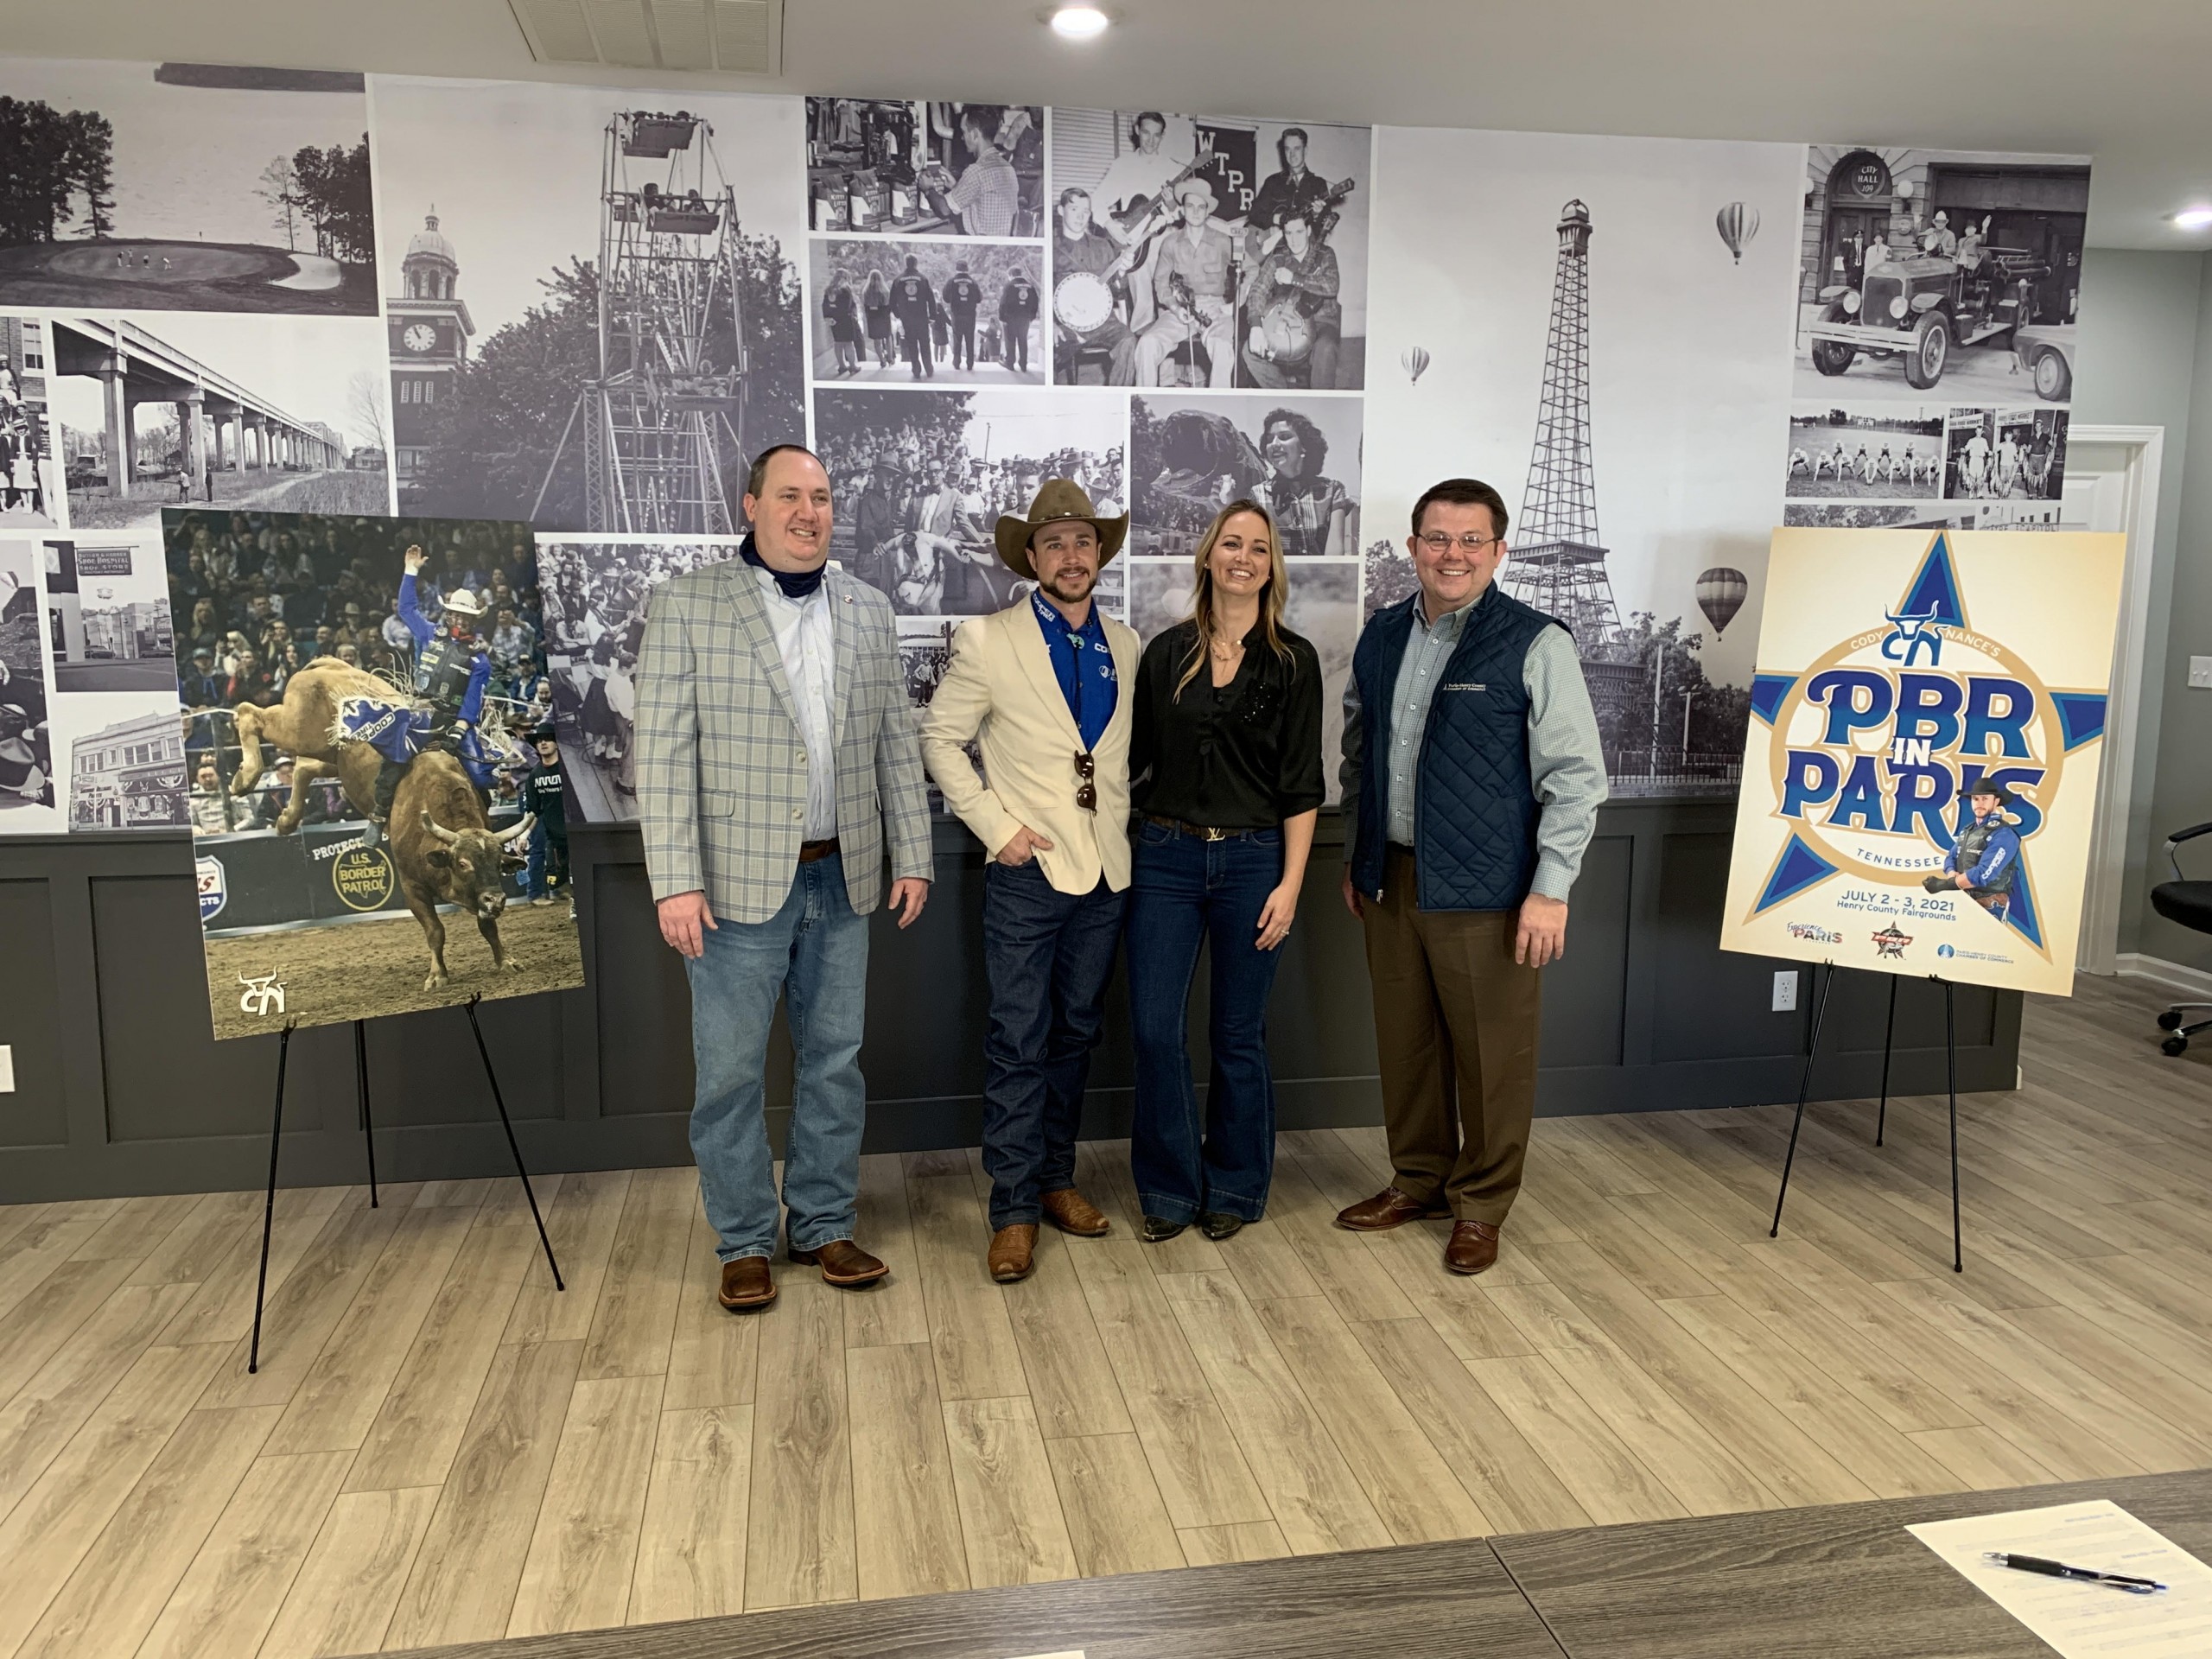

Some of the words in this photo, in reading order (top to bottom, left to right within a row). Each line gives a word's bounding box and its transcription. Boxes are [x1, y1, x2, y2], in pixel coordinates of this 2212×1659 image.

[1858, 175, 1878, 184] HALL
[1861, 165, 1878, 175] CITY
[1861, 184, 1874, 193] 109
[97, 556, 129, 565] HOSPITAL
[1850, 631, 1884, 650] CODY
[1945, 628, 2001, 658] NANCE'S
[1807, 670, 2035, 760] PBR
[361, 713, 395, 742] COOPE
[1892, 735, 1933, 766] IN
[312, 836, 365, 861] PROTECT
[1857, 848, 1942, 868] TENNESSEE
[350, 853, 372, 865] U.S.
[340, 867, 386, 881] BORDER
[342, 880, 387, 894] PATROL
[1837, 900, 1865, 912] Henry
[1866, 904, 1899, 916] County
[1902, 907, 1957, 921] Fairgrounds
[1841, 890, 1877, 903] JULY
[1880, 893, 1891, 905] 2
[1904, 897, 1916, 910] 3,
[1920, 898, 1955, 912] 2021
[1787, 921, 1823, 932] Experience
